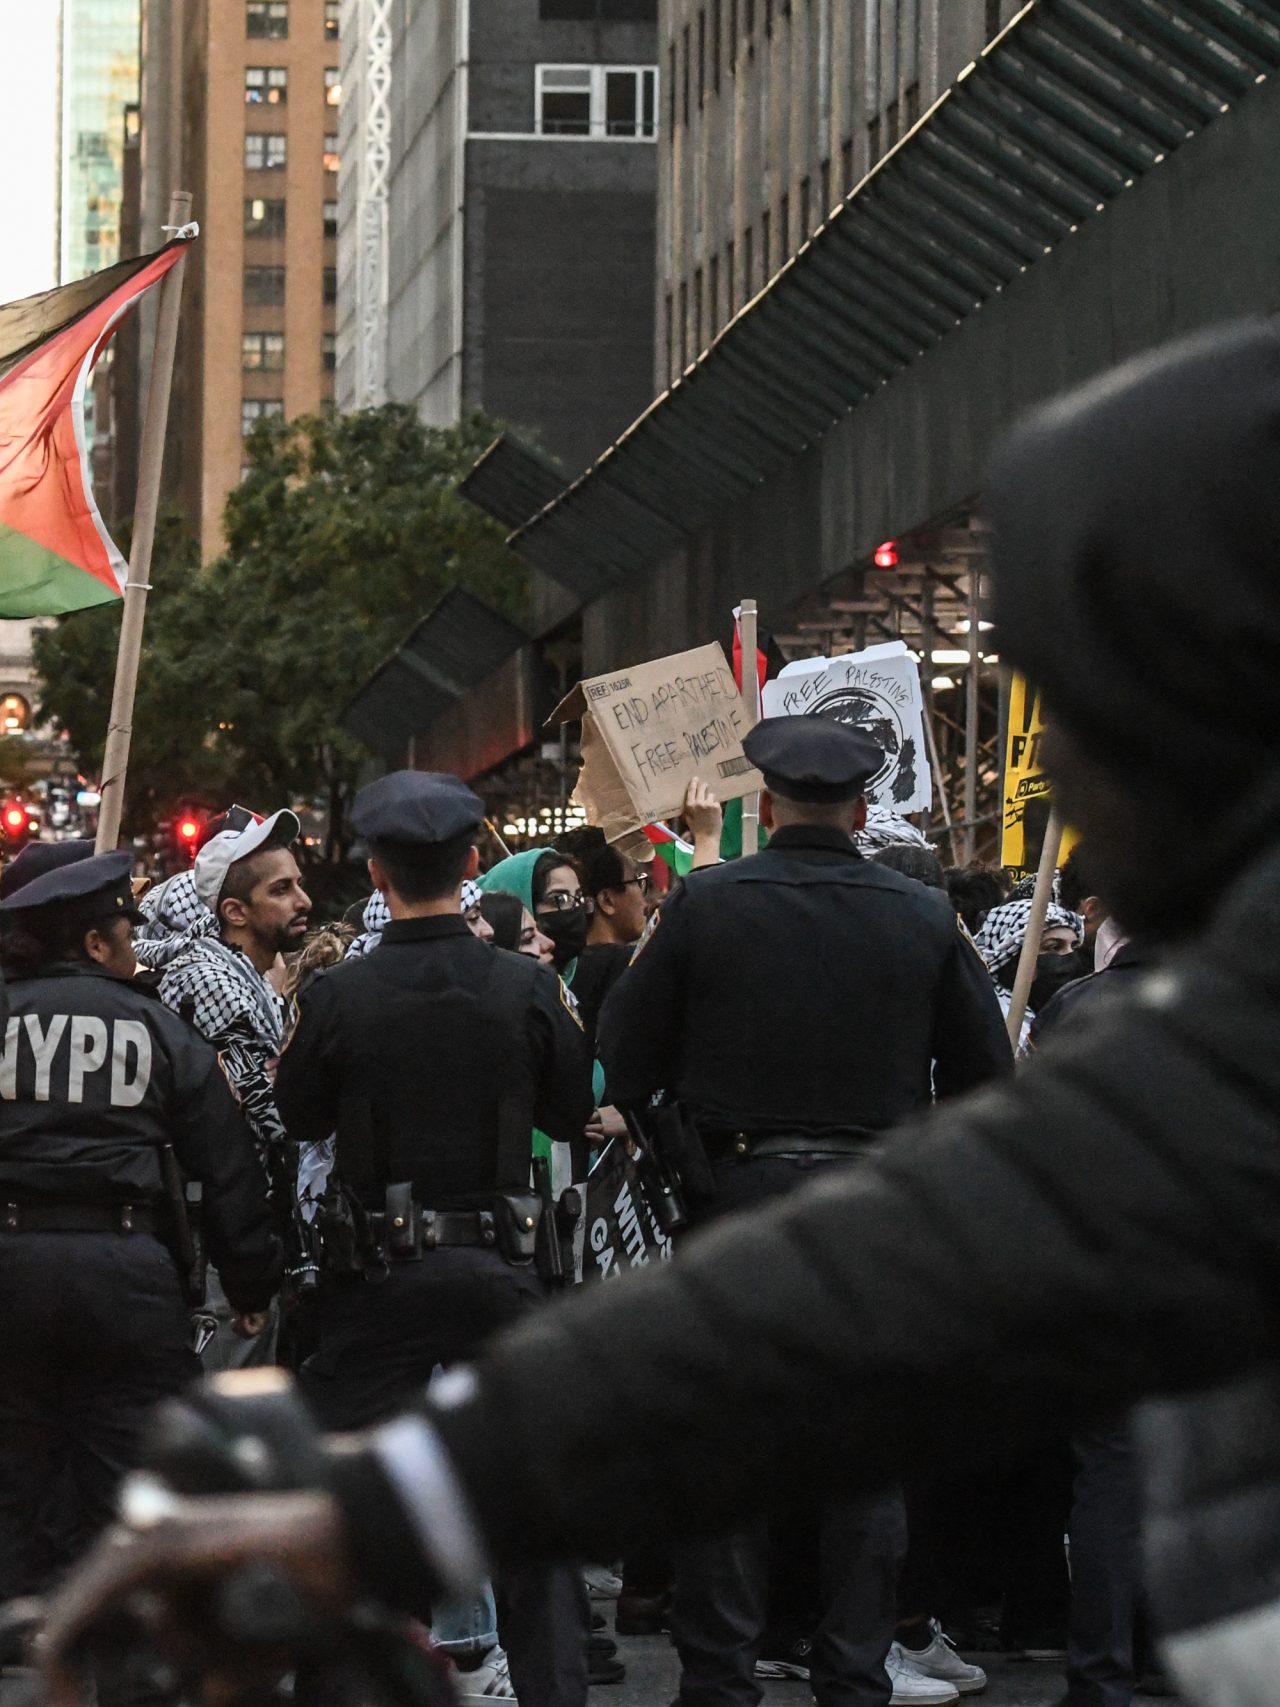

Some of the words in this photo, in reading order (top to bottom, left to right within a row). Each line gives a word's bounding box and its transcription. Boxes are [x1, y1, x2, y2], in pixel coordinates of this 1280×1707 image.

[589, 684, 607, 699] REF
[612, 698, 650, 731] END
[651, 667, 739, 719] APARTHEID
[783, 671, 833, 716] FREE
[845, 665, 909, 708] PALESTINE
[630, 741, 680, 792] FREE
[590, 1217, 620, 1281] GA
